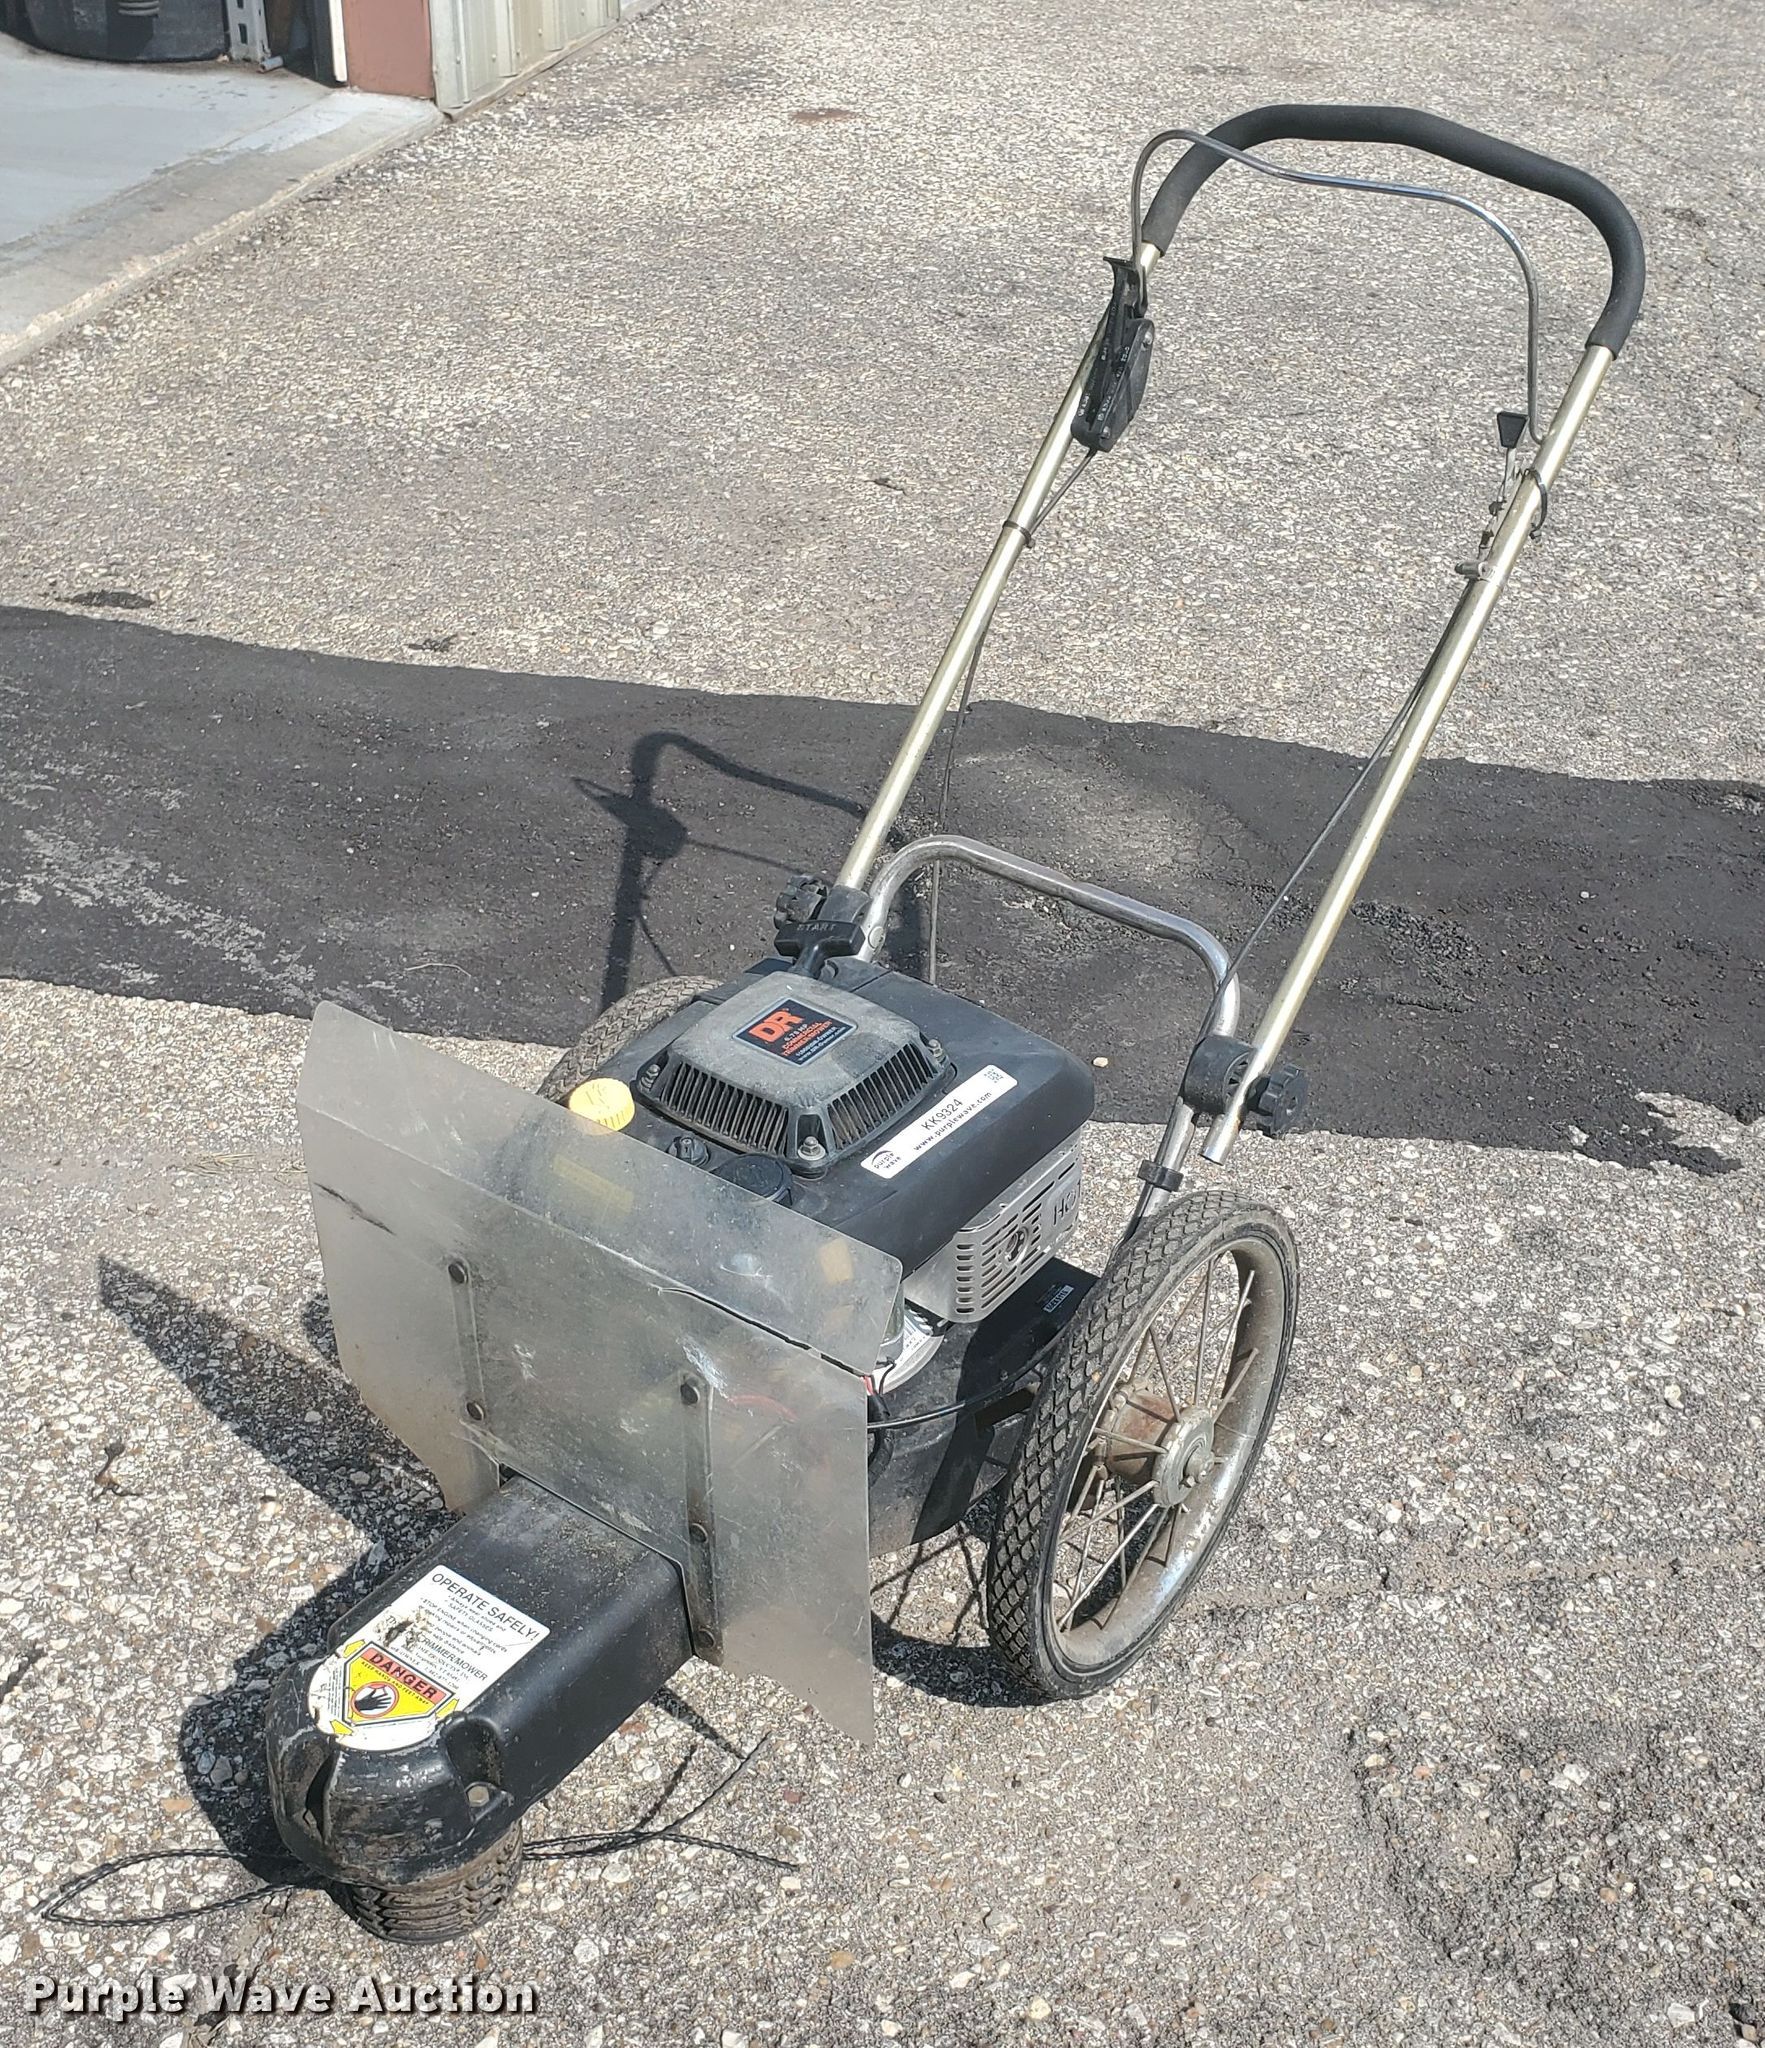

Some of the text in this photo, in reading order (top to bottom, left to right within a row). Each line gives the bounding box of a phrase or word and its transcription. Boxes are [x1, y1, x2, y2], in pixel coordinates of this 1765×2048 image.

[796, 923, 837, 931] START
[749, 1010, 804, 1042] DR
[797, 1023, 809, 1031] HP
[913, 1092, 992, 1150] www.purplewave.com
[921, 1098, 963, 1130] KK9324
[873, 1152, 895, 1168] purple
[885, 1156, 902, 1168] wave
[1053, 1179, 1081, 1225] HOT
[432, 1573, 540, 1640] OPERATE SAFELY!
[360, 1661, 374, 1670] KEEP
[369, 1653, 440, 1698] DANGER
